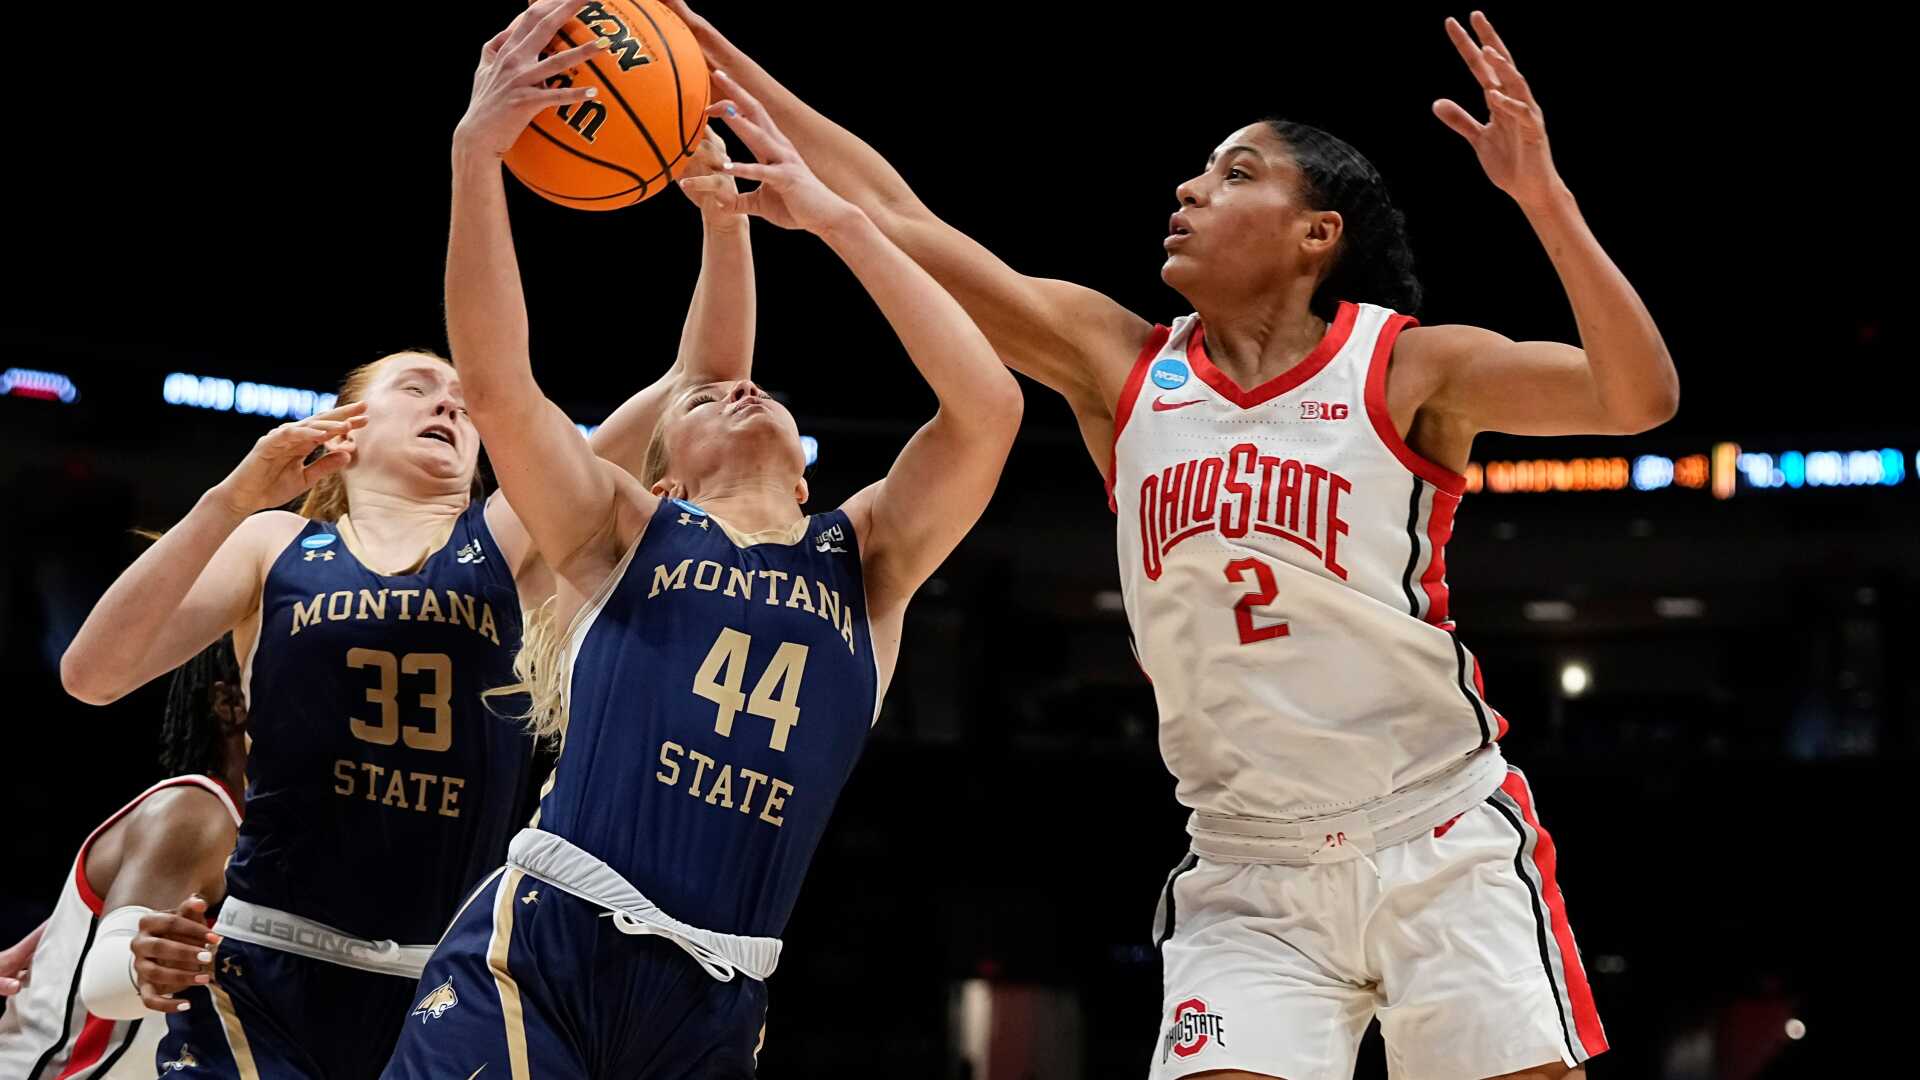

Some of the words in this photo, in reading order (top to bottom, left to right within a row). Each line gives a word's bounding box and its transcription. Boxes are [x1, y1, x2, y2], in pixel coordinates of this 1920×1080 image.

[289, 588, 500, 646] MONTANA
[647, 558, 855, 655] MONTANA
[1223, 557, 1290, 646] 2
[346, 647, 452, 752] 33
[692, 626, 809, 752] 44
[333, 759, 466, 818] STATE
[656, 740, 794, 827] STATE
